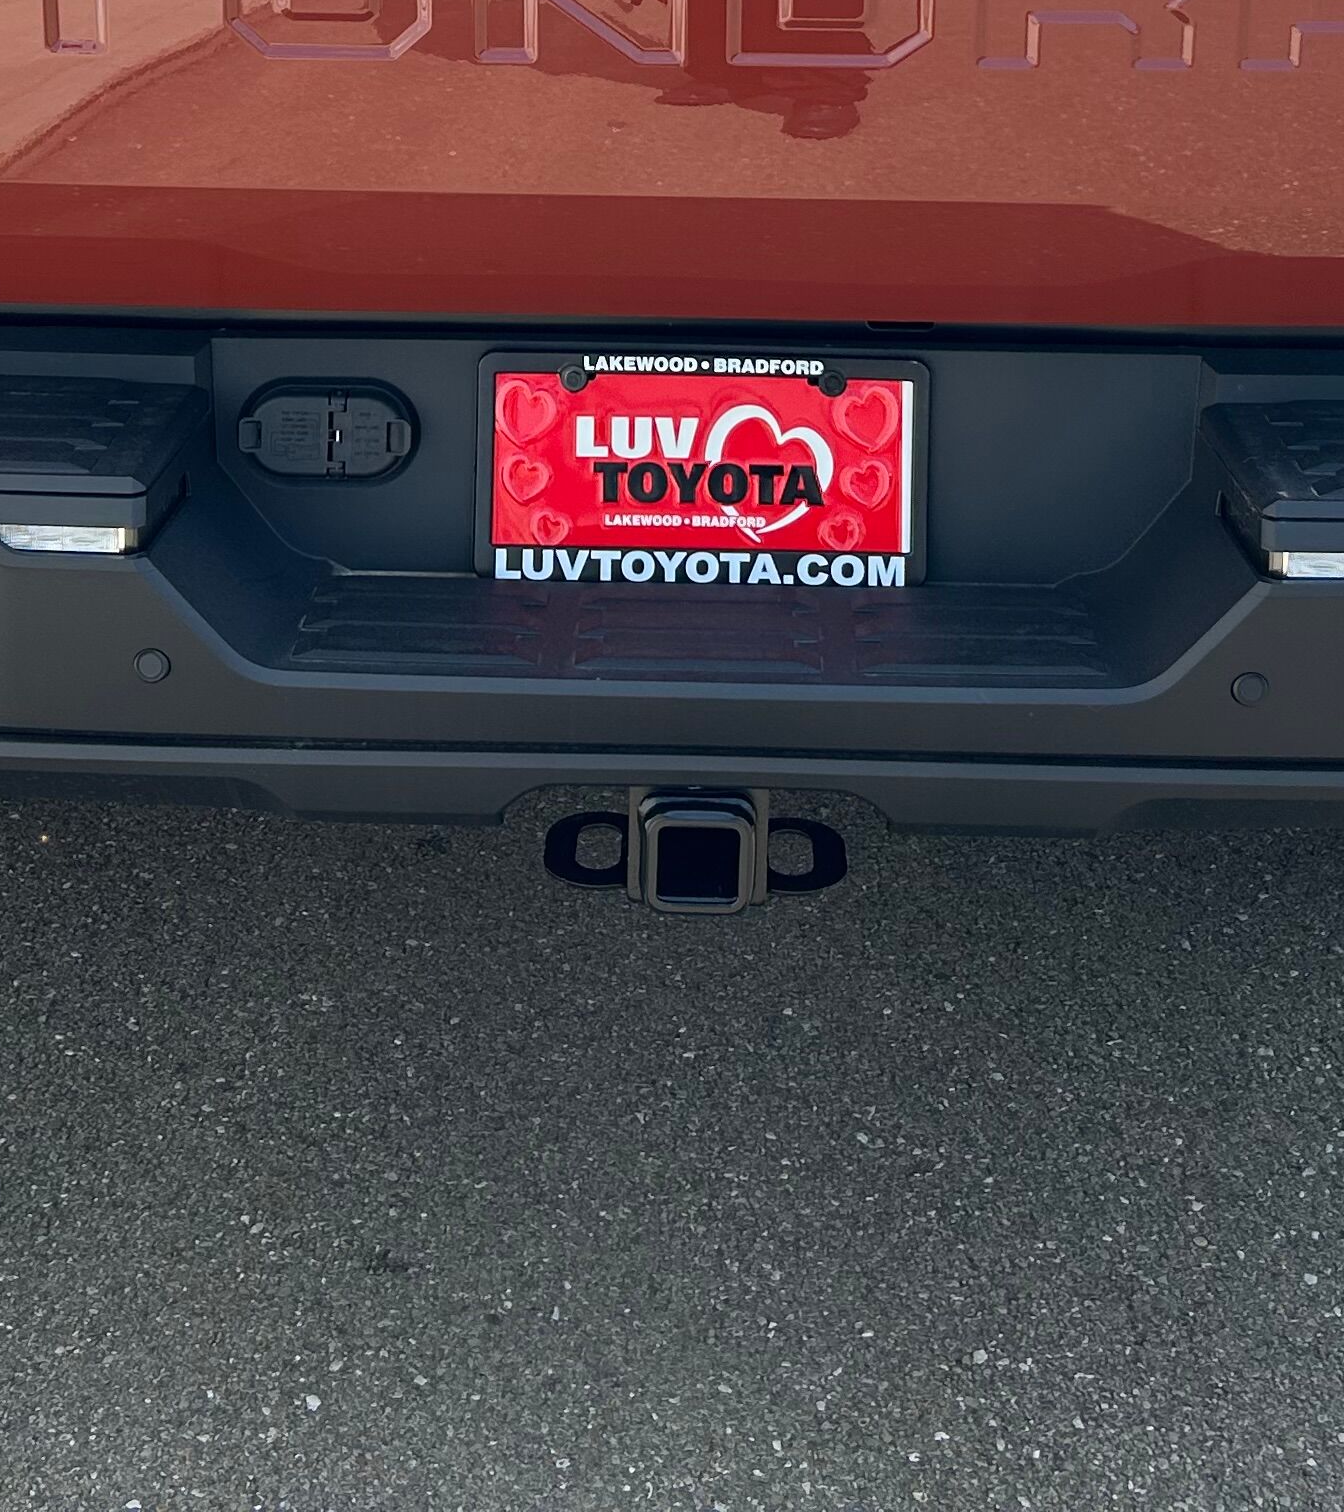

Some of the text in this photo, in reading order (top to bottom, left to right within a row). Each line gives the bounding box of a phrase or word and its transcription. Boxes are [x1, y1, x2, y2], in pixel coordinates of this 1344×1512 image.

[583, 355, 825, 376] LAKEWOOD BRADFORD
[574, 416, 700, 460] LUV
[593, 461, 825, 507] TOYOTA
[604, 514, 766, 530] LAKEWOOD BRADFORD
[494, 548, 906, 587] LUVTOYOTA.COM
